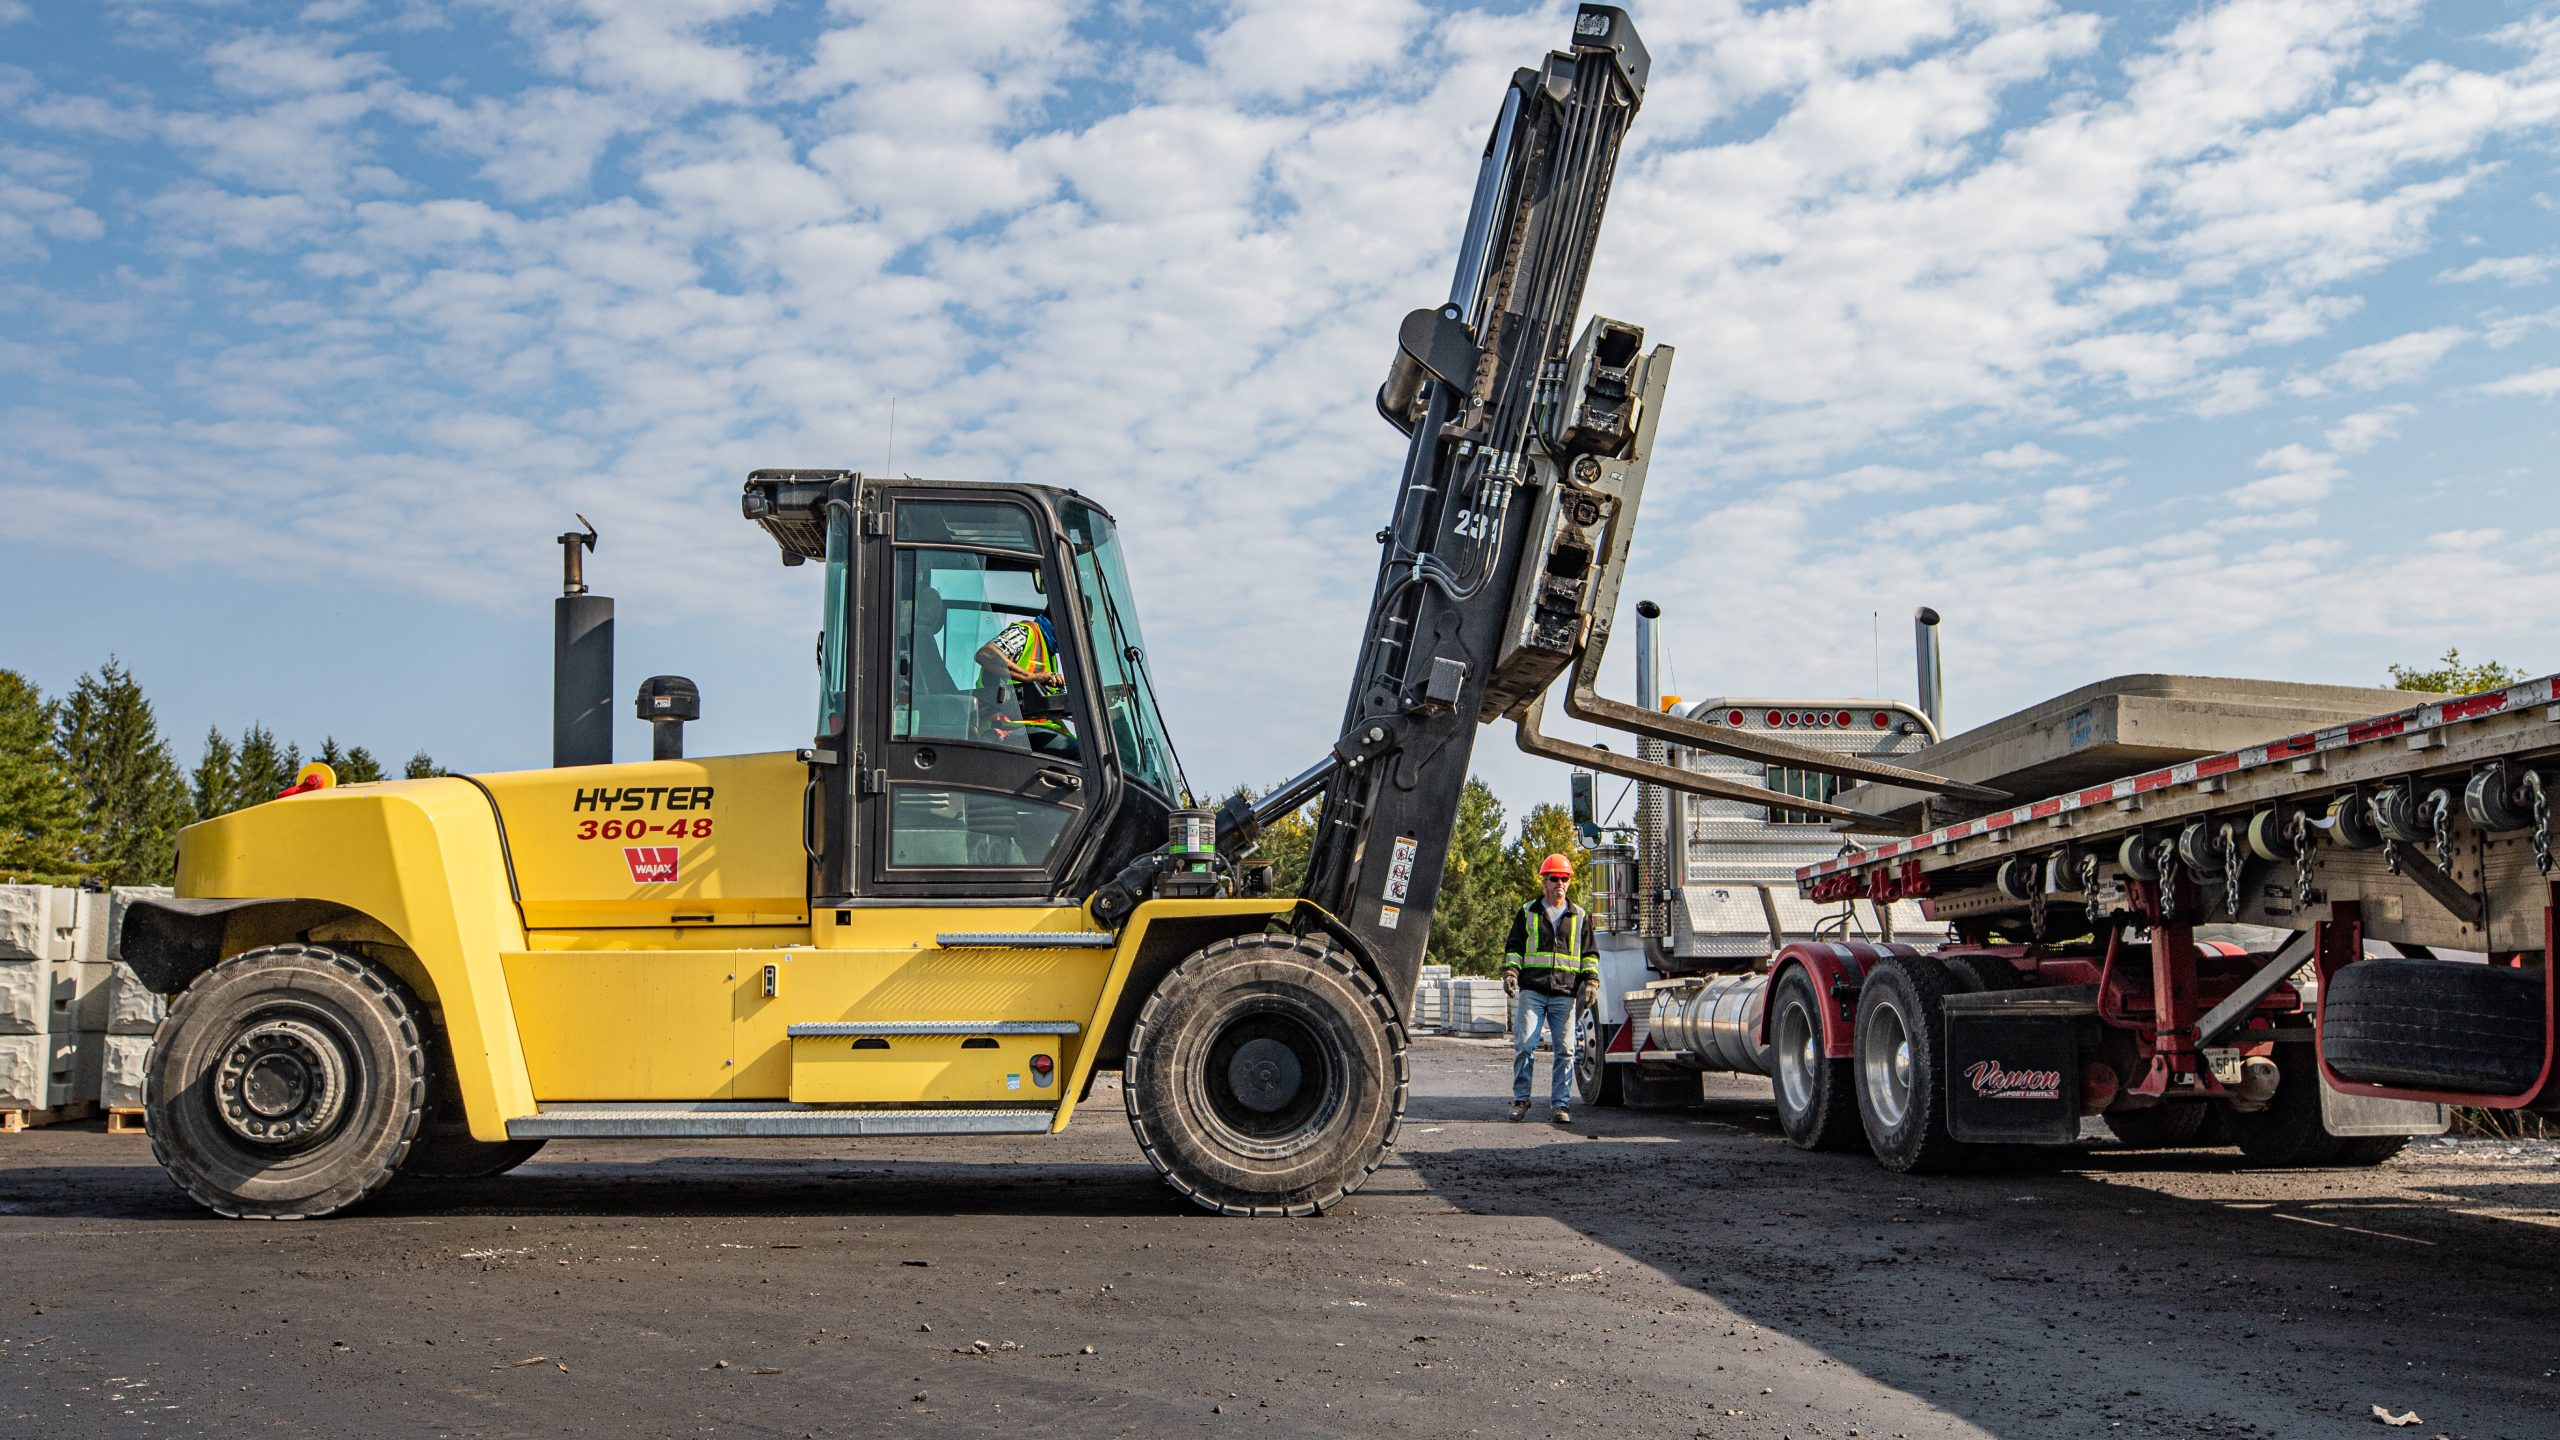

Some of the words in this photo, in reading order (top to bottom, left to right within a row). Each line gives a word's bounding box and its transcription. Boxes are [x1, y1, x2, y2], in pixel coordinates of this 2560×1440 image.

[573, 786, 714, 812] HYSTER
[576, 818, 713, 840] 360-48
[635, 864, 672, 876] WAJAX
[1964, 1060, 2060, 1090] Vanson
